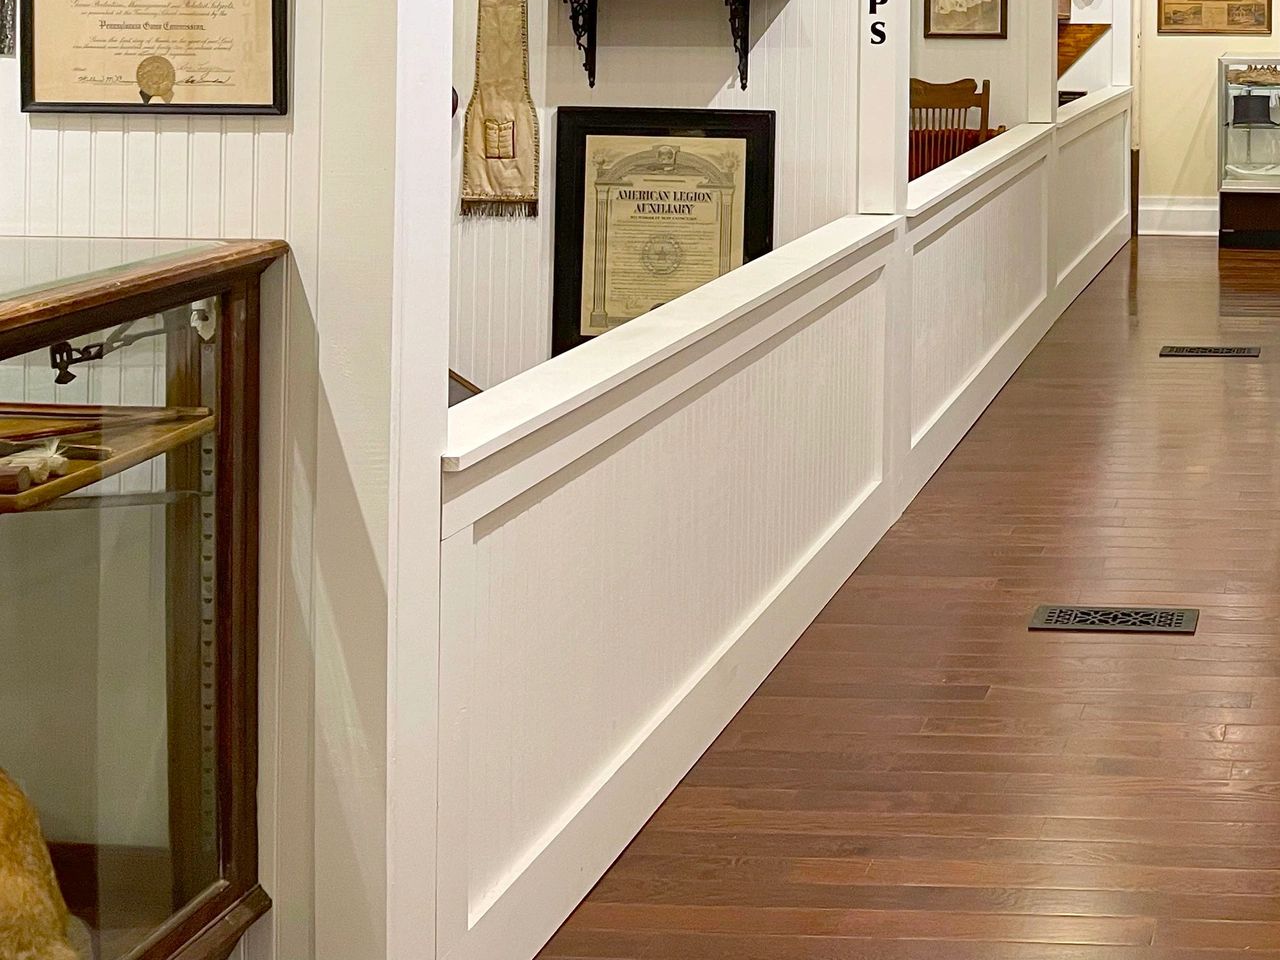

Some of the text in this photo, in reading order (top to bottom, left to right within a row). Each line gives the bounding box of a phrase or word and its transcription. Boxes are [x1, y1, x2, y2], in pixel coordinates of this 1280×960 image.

[616, 190, 712, 202] AMERICAN LEGION
[634, 203, 695, 214] AUXILIARY
